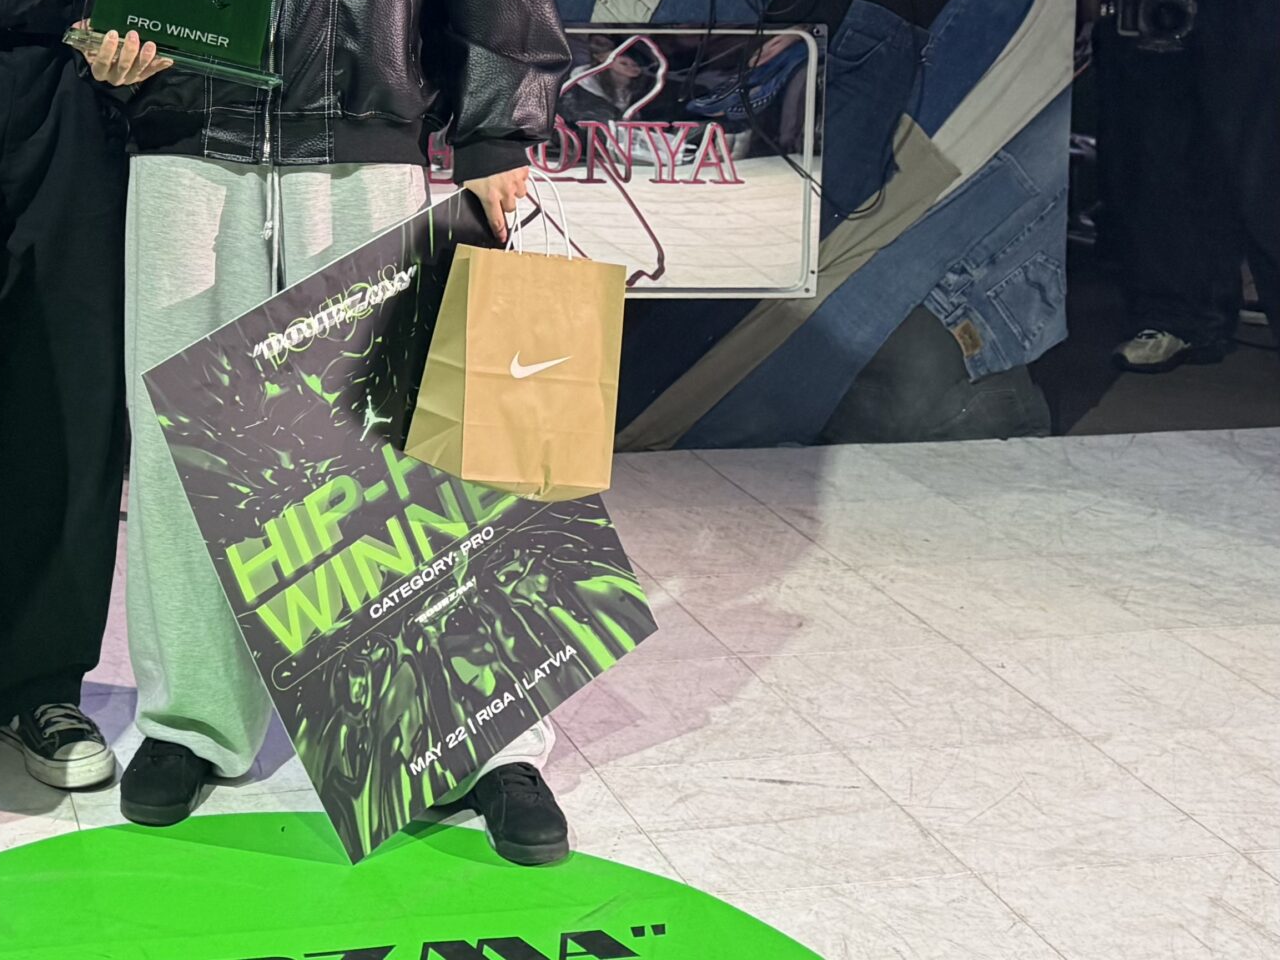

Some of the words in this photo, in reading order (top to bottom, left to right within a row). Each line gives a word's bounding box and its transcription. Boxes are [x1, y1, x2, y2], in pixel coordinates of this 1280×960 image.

[126, 14, 162, 31] PRO
[166, 23, 230, 47] WINNER
[369, 551, 460, 619] CATEGORY:
[460, 526, 495, 555] PRO
[408, 741, 442, 776] MAY
[445, 726, 468, 749] 22
[475, 691, 516, 726] RIGA
[521, 644, 578, 690] LATVIA
